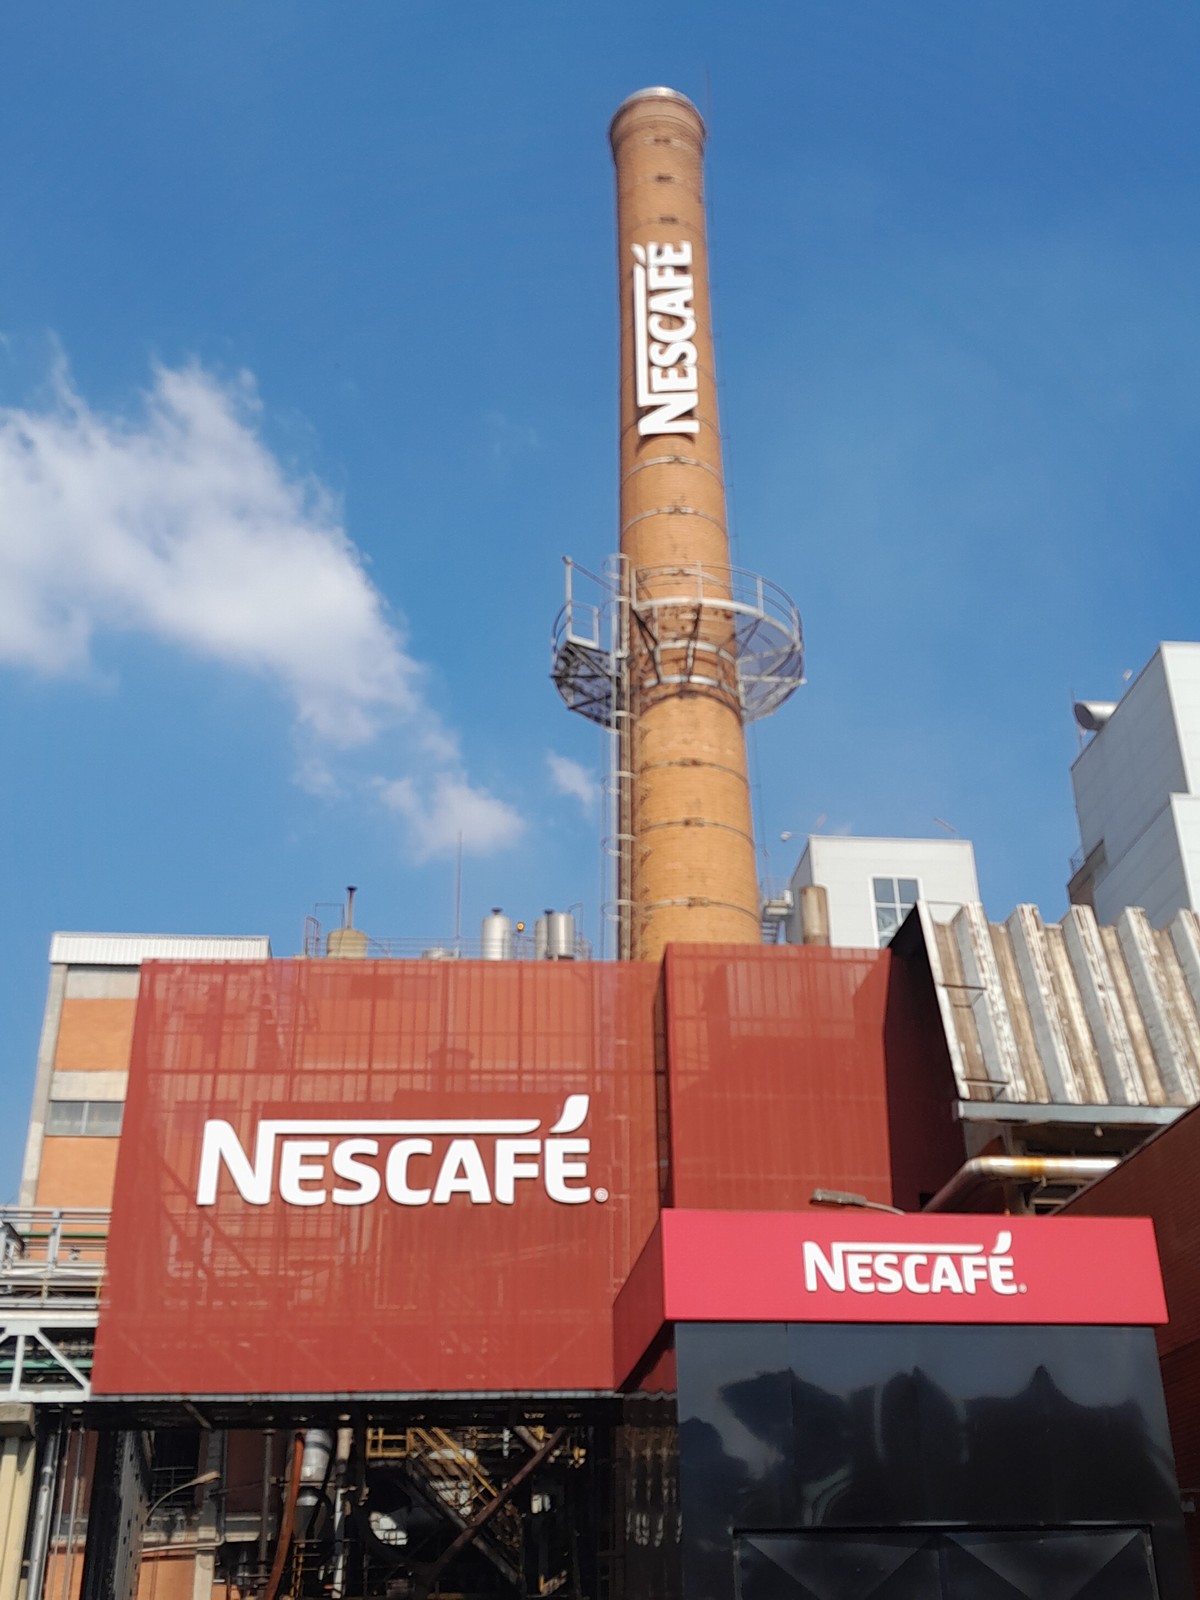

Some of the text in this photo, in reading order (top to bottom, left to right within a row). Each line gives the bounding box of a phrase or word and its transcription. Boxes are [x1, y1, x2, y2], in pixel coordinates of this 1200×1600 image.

[632, 240, 700, 436] NESCAFÉ
[196, 1094, 591, 1206] NESCAFÉ
[802, 1230, 1018, 1295] NESCAFÉ
